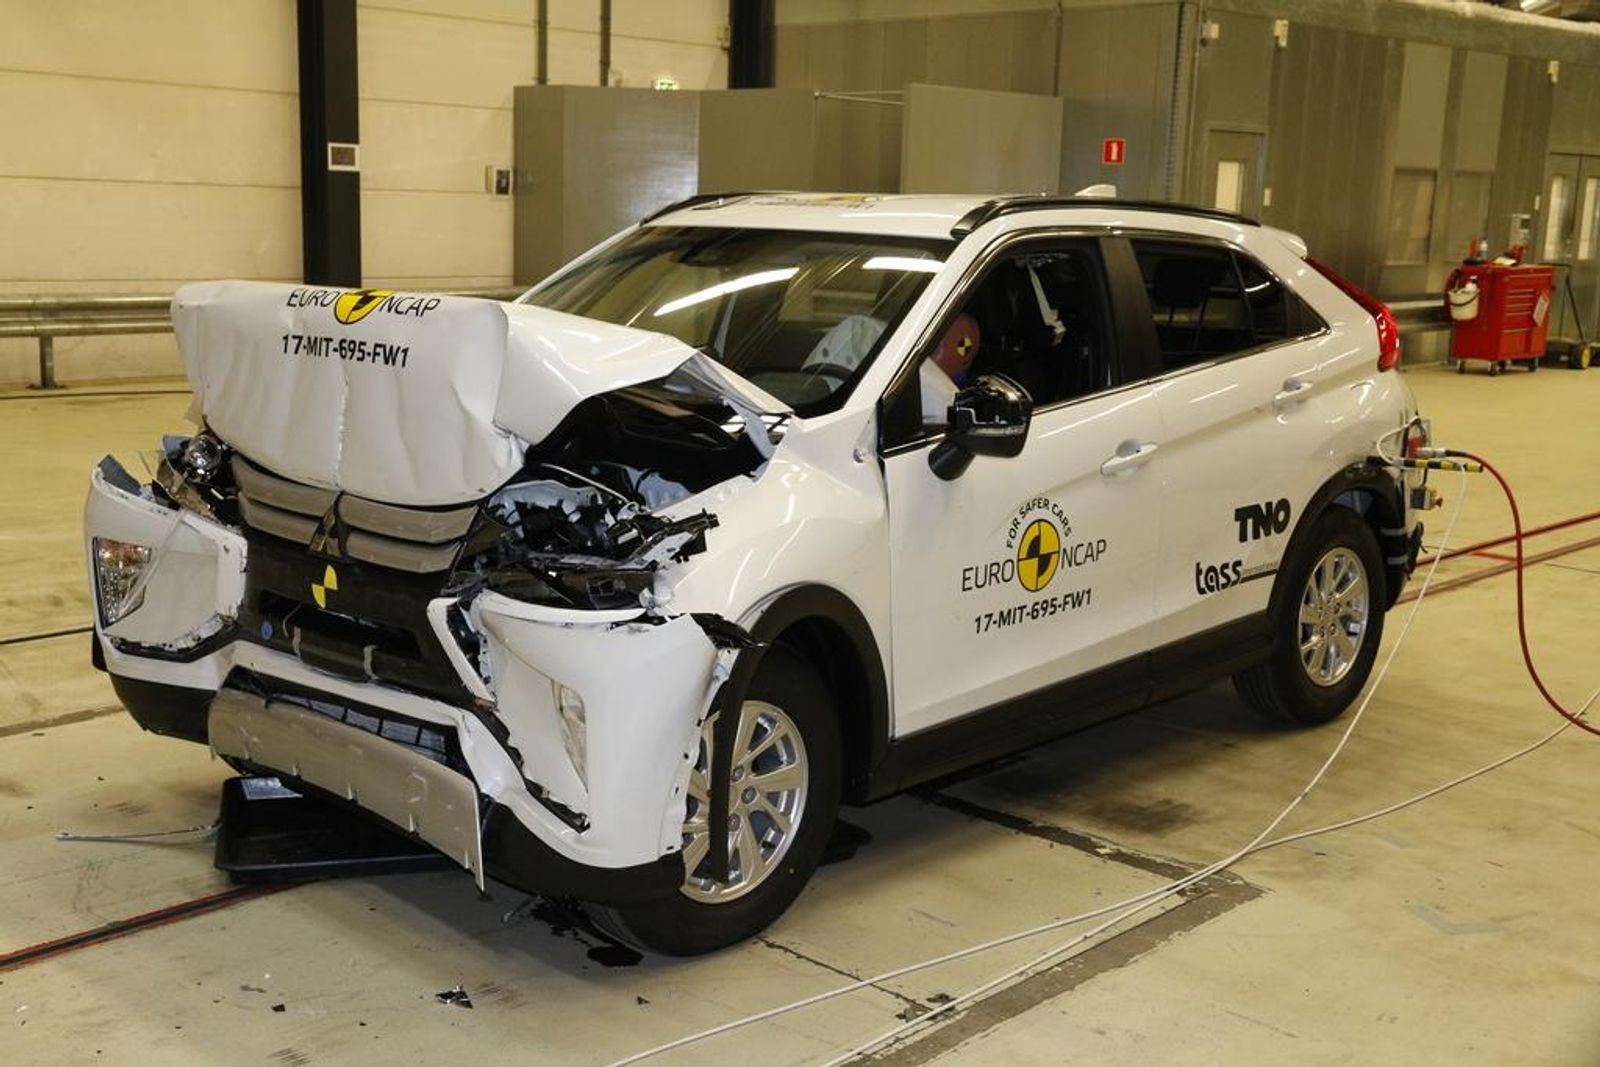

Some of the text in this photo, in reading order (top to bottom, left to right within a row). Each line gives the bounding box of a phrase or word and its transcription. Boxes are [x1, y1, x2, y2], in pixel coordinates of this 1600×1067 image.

[286, 288, 441, 317] EURO NCAP
[282, 333, 410, 368] 17-MIT-695-FW1
[1006, 497, 1072, 549] FOR SAFER CARS
[1234, 498, 1291, 543] TNO
[961, 539, 1107, 592] EURO NCAP
[974, 588, 1092, 634] 17-MIT-695-FW1
